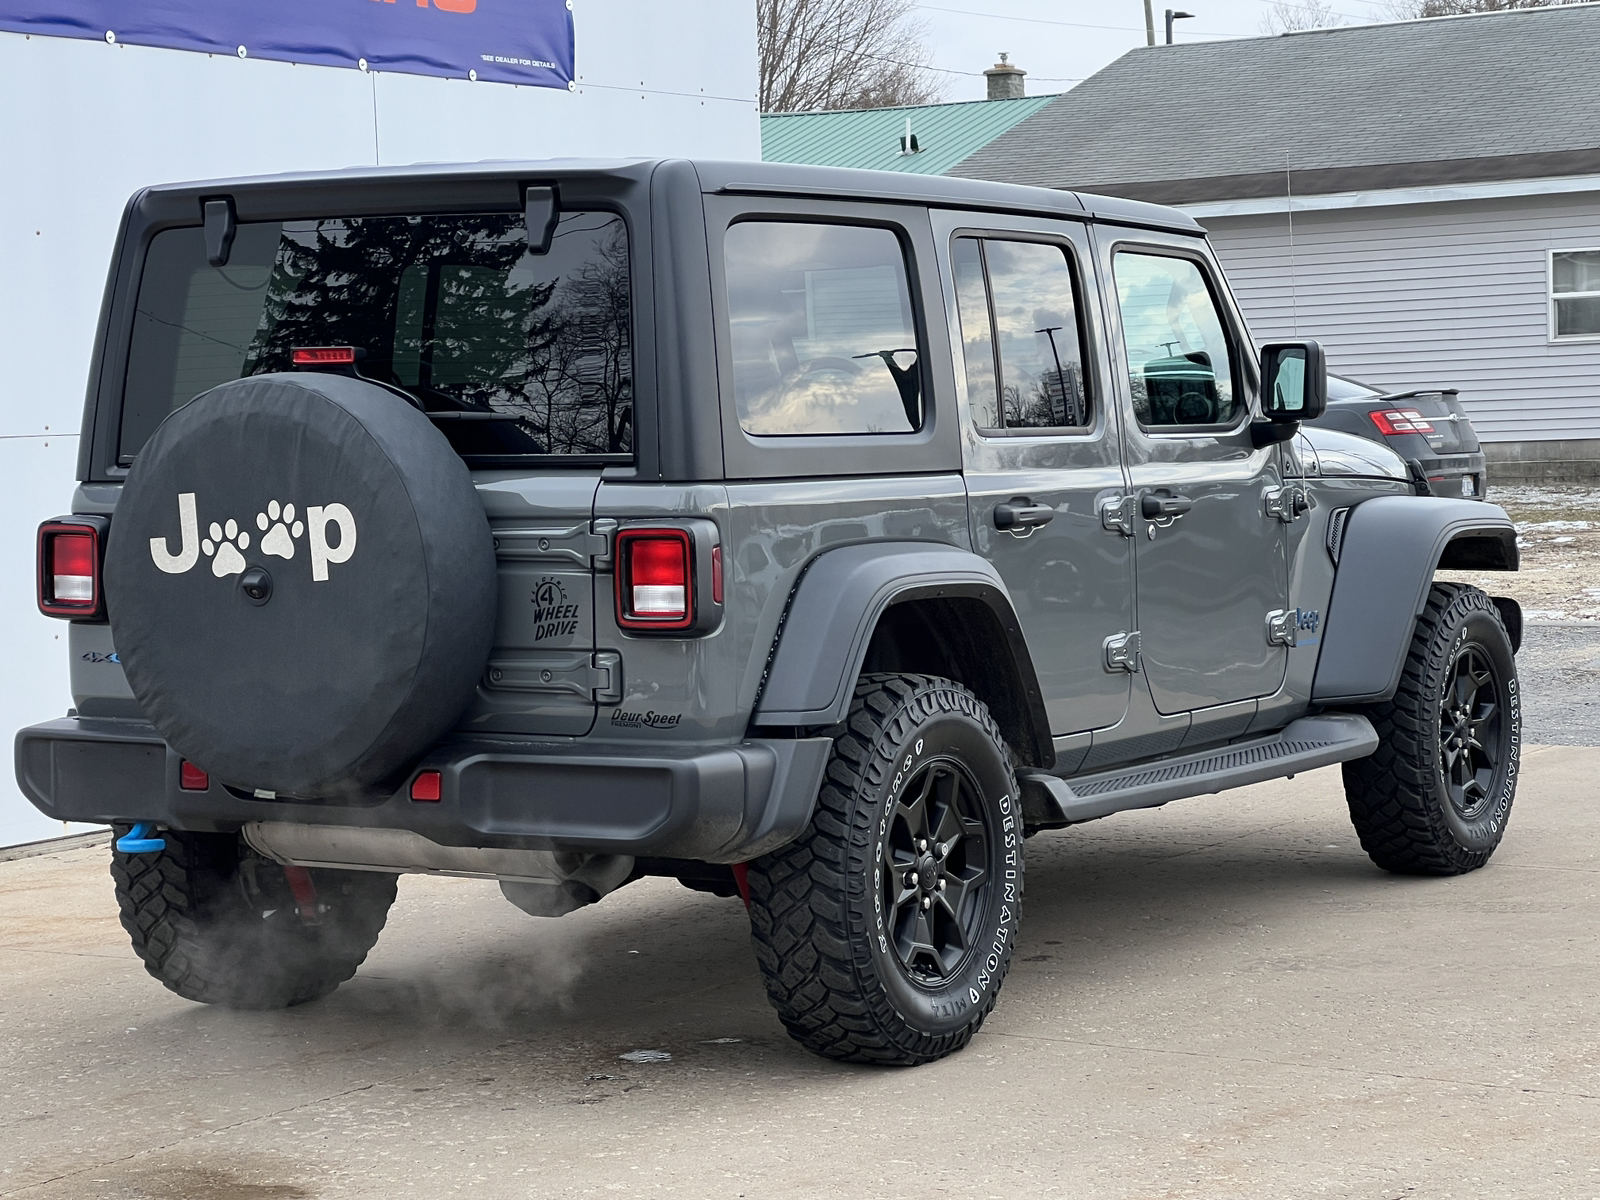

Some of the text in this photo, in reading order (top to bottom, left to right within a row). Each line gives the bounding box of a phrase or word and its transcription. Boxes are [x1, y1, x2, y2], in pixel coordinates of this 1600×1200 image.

[495, 56, 518, 65] DEALER
[519, 58, 531, 66] FOR
[531, 60, 556, 69] DETAILS
[540, 585, 555, 606] 4
[533, 604, 579, 625] WHEEL
[534, 620, 579, 642] DRIVE
[1494, 677, 1520, 825] DESTINATION
[977, 794, 1017, 991] DESTINATION
